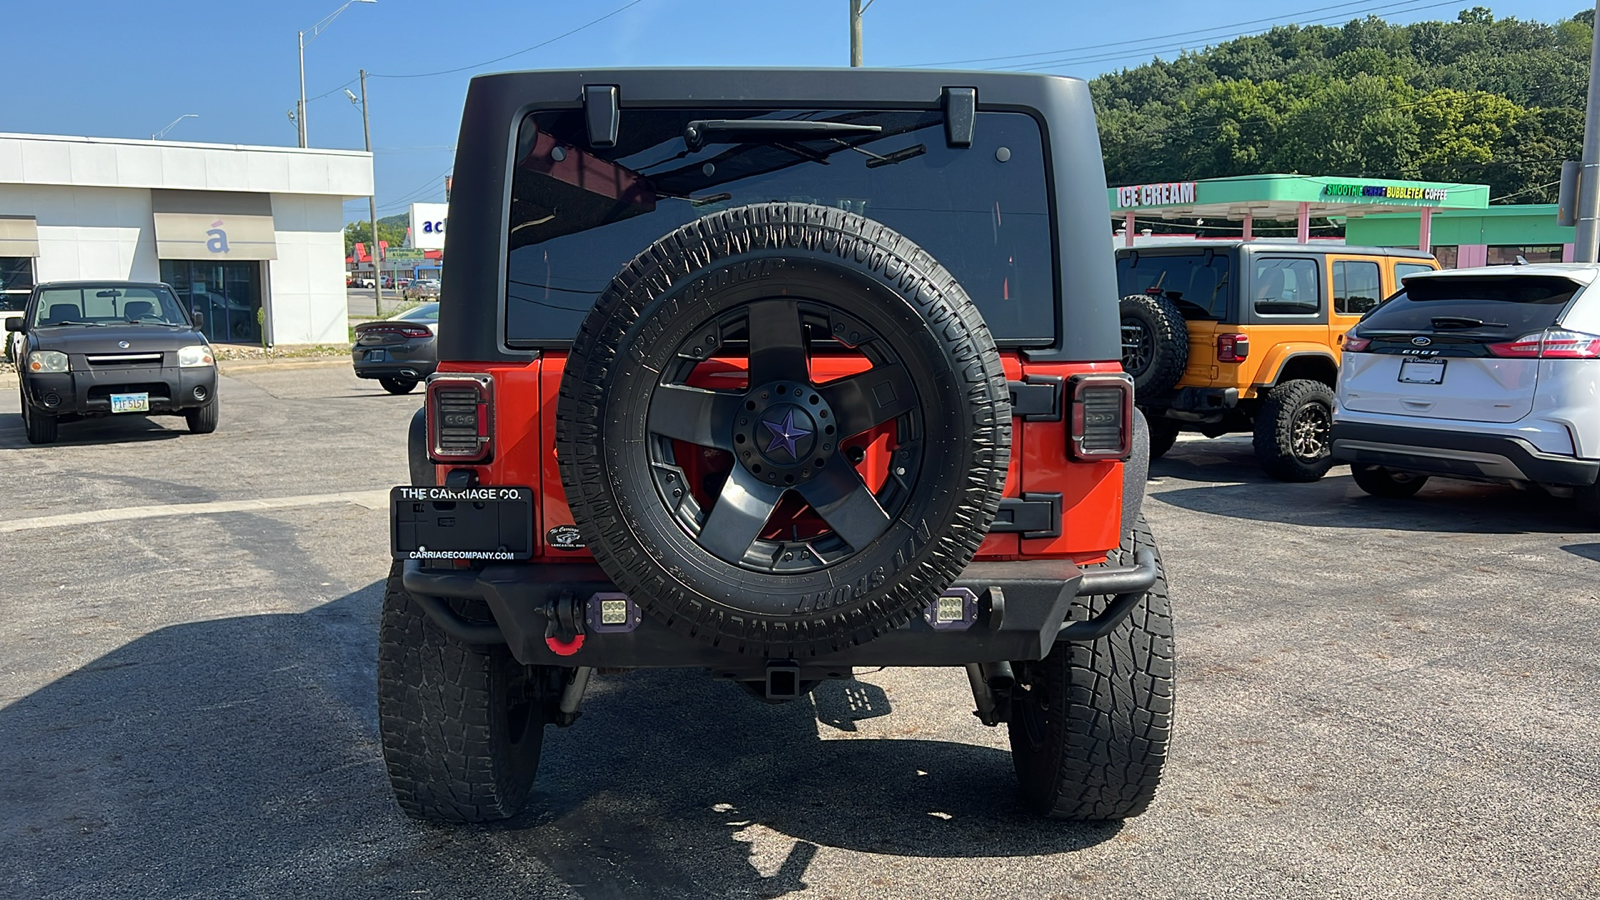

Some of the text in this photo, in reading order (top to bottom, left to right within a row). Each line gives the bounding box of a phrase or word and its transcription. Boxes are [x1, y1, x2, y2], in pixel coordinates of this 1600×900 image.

[1117, 182, 1196, 208] ICE CREAM
[1327, 184, 1363, 197] SMOOTHIE
[1424, 188, 1448, 201] COFFEE
[423, 217, 448, 234] ac
[206, 219, 230, 254] á
[114, 399, 146, 409] FIF 5157
[401, 488, 427, 500] THE
[500, 489, 522, 500] CO.
[409, 551, 515, 560] CARRIAGECOMPANY.COM
